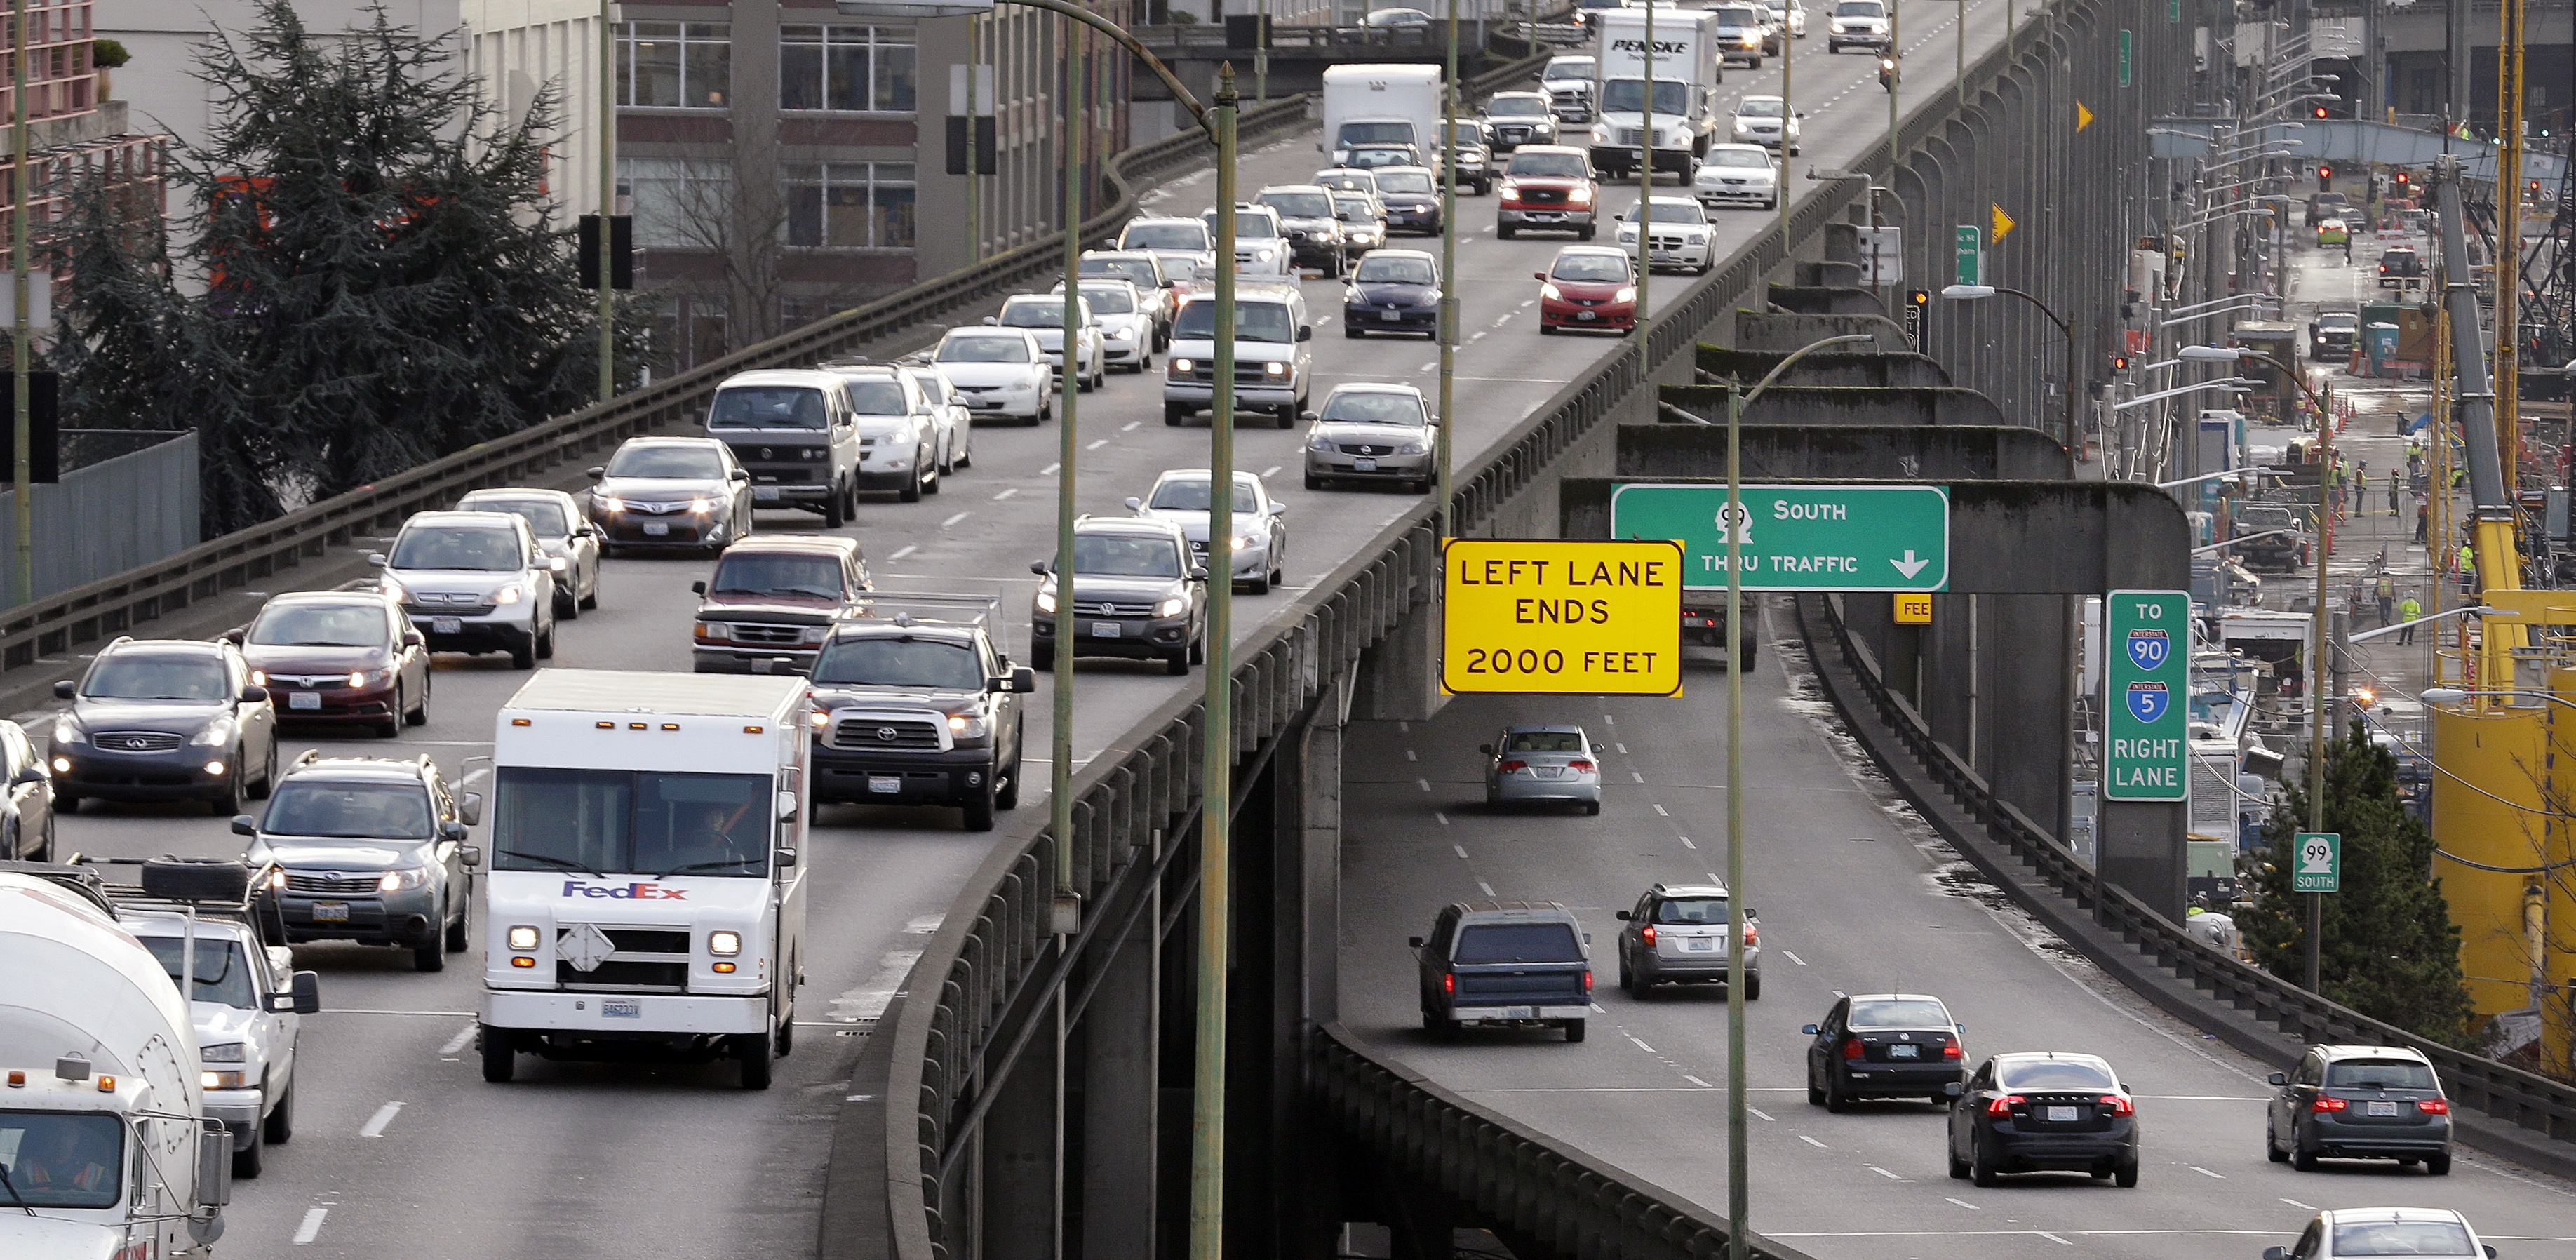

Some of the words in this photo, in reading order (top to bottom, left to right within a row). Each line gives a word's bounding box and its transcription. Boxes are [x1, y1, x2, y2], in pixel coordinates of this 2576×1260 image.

[1611, 40, 1689, 54] PENSKE
[1773, 500, 1846, 520] SOUTH
[1461, 560, 1549, 586] LEFT
[1569, 561, 1664, 587] LANE
[1771, 556, 1858, 572] TRAFFIC
[1516, 598, 1609, 624] ENDS
[1905, 602, 1930, 615] FEE
[2135, 603, 2163, 619] TO
[1467, 648, 1564, 674] 2000
[1584, 651, 1657, 673] FEET
[2135, 641, 2163, 661] 90
[2141, 693, 2155, 713] 5
[2114, 739, 2180, 759] RIGHT
[2115, 767, 2178, 787] LANE
[2307, 845, 2327, 861] 99
[562, 880, 688, 900] FedEx
[2297, 876, 2335, 888] SOUTH
